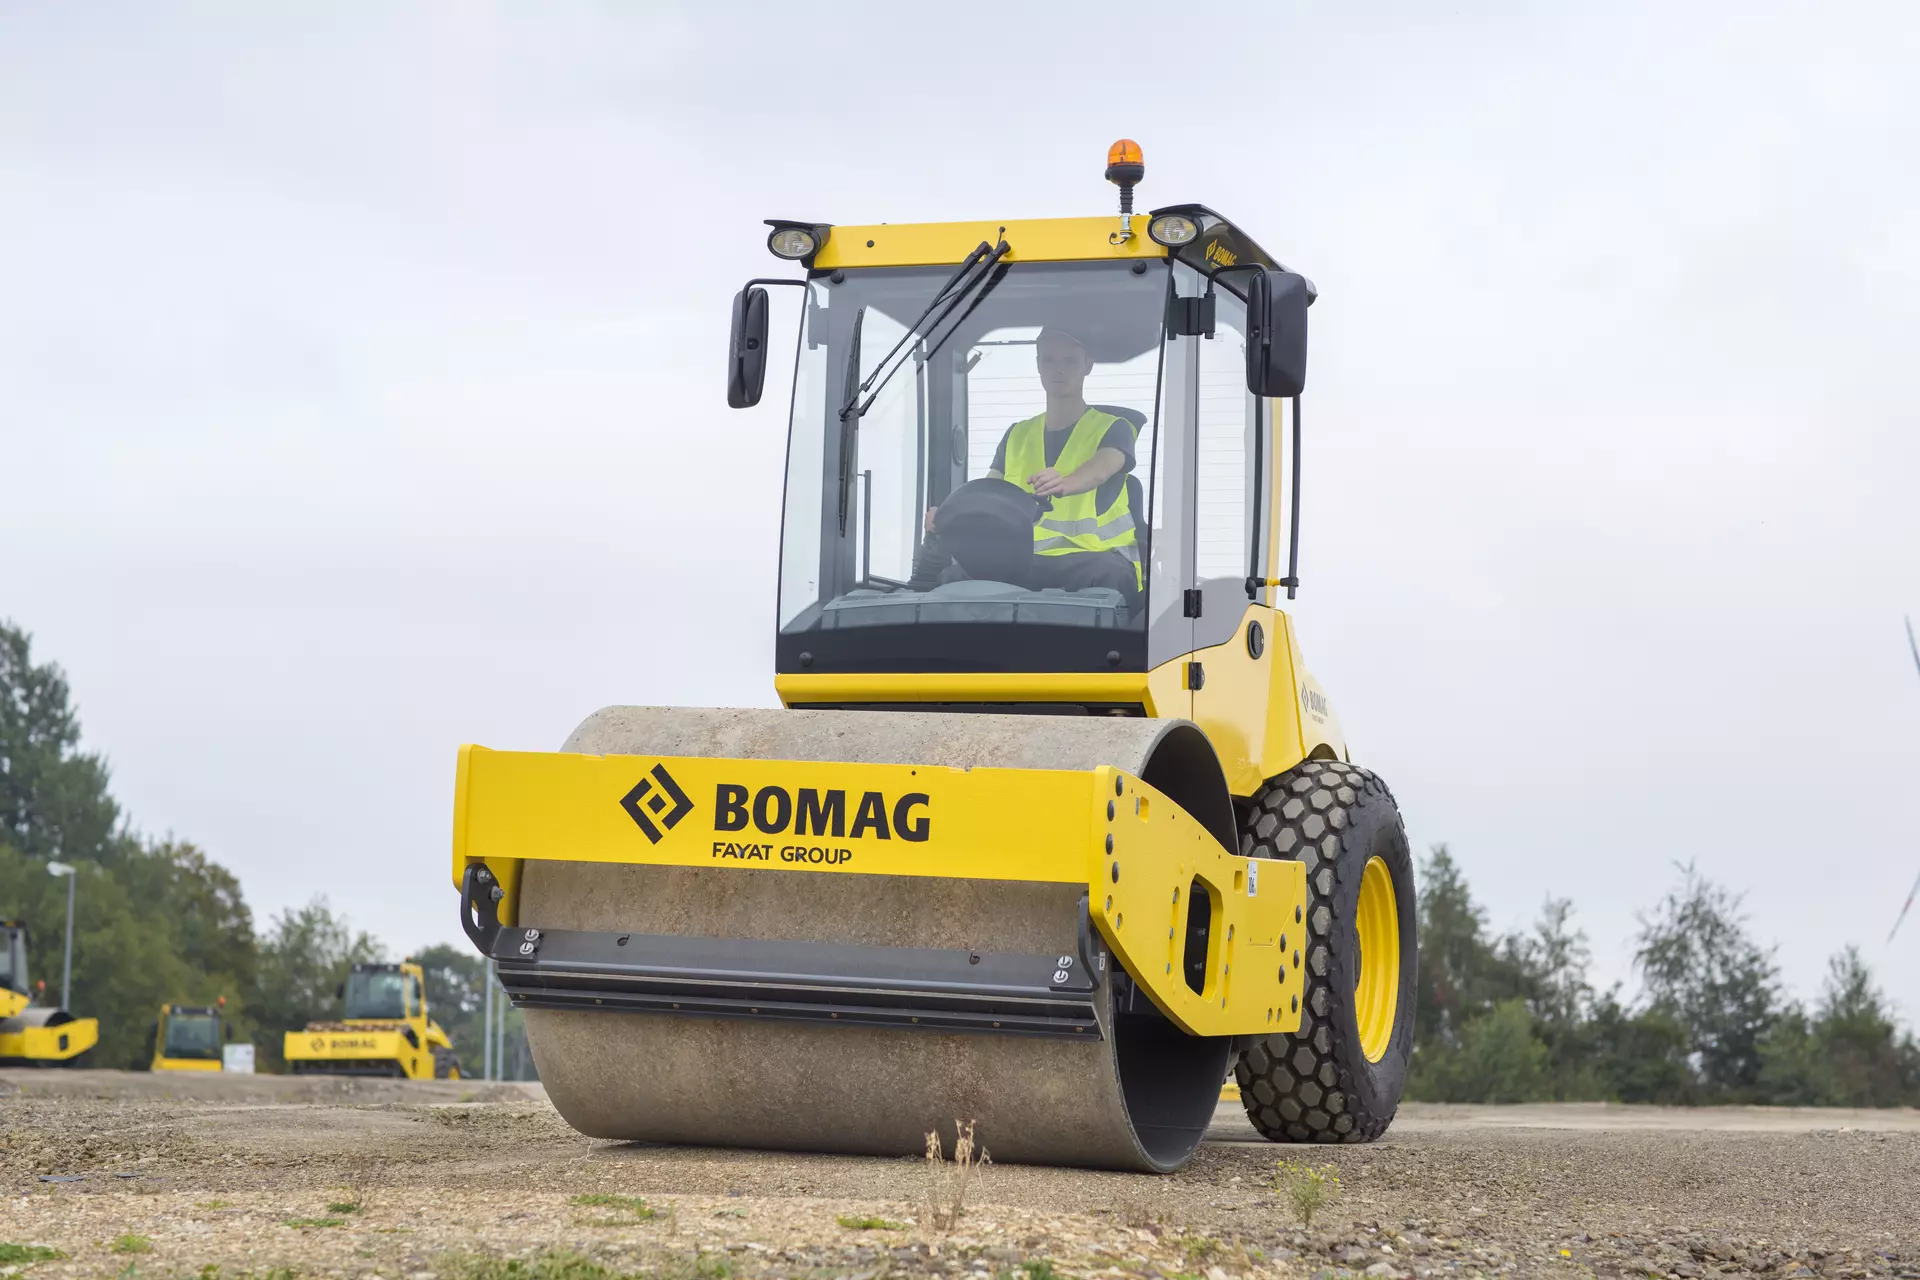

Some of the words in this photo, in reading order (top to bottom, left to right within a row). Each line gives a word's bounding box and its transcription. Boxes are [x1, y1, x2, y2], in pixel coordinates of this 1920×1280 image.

[1213, 246, 1237, 266] BOMAG
[714, 784, 930, 842] BOMAG
[712, 842, 773, 860] FAYAT
[780, 846, 852, 864] GROUP
